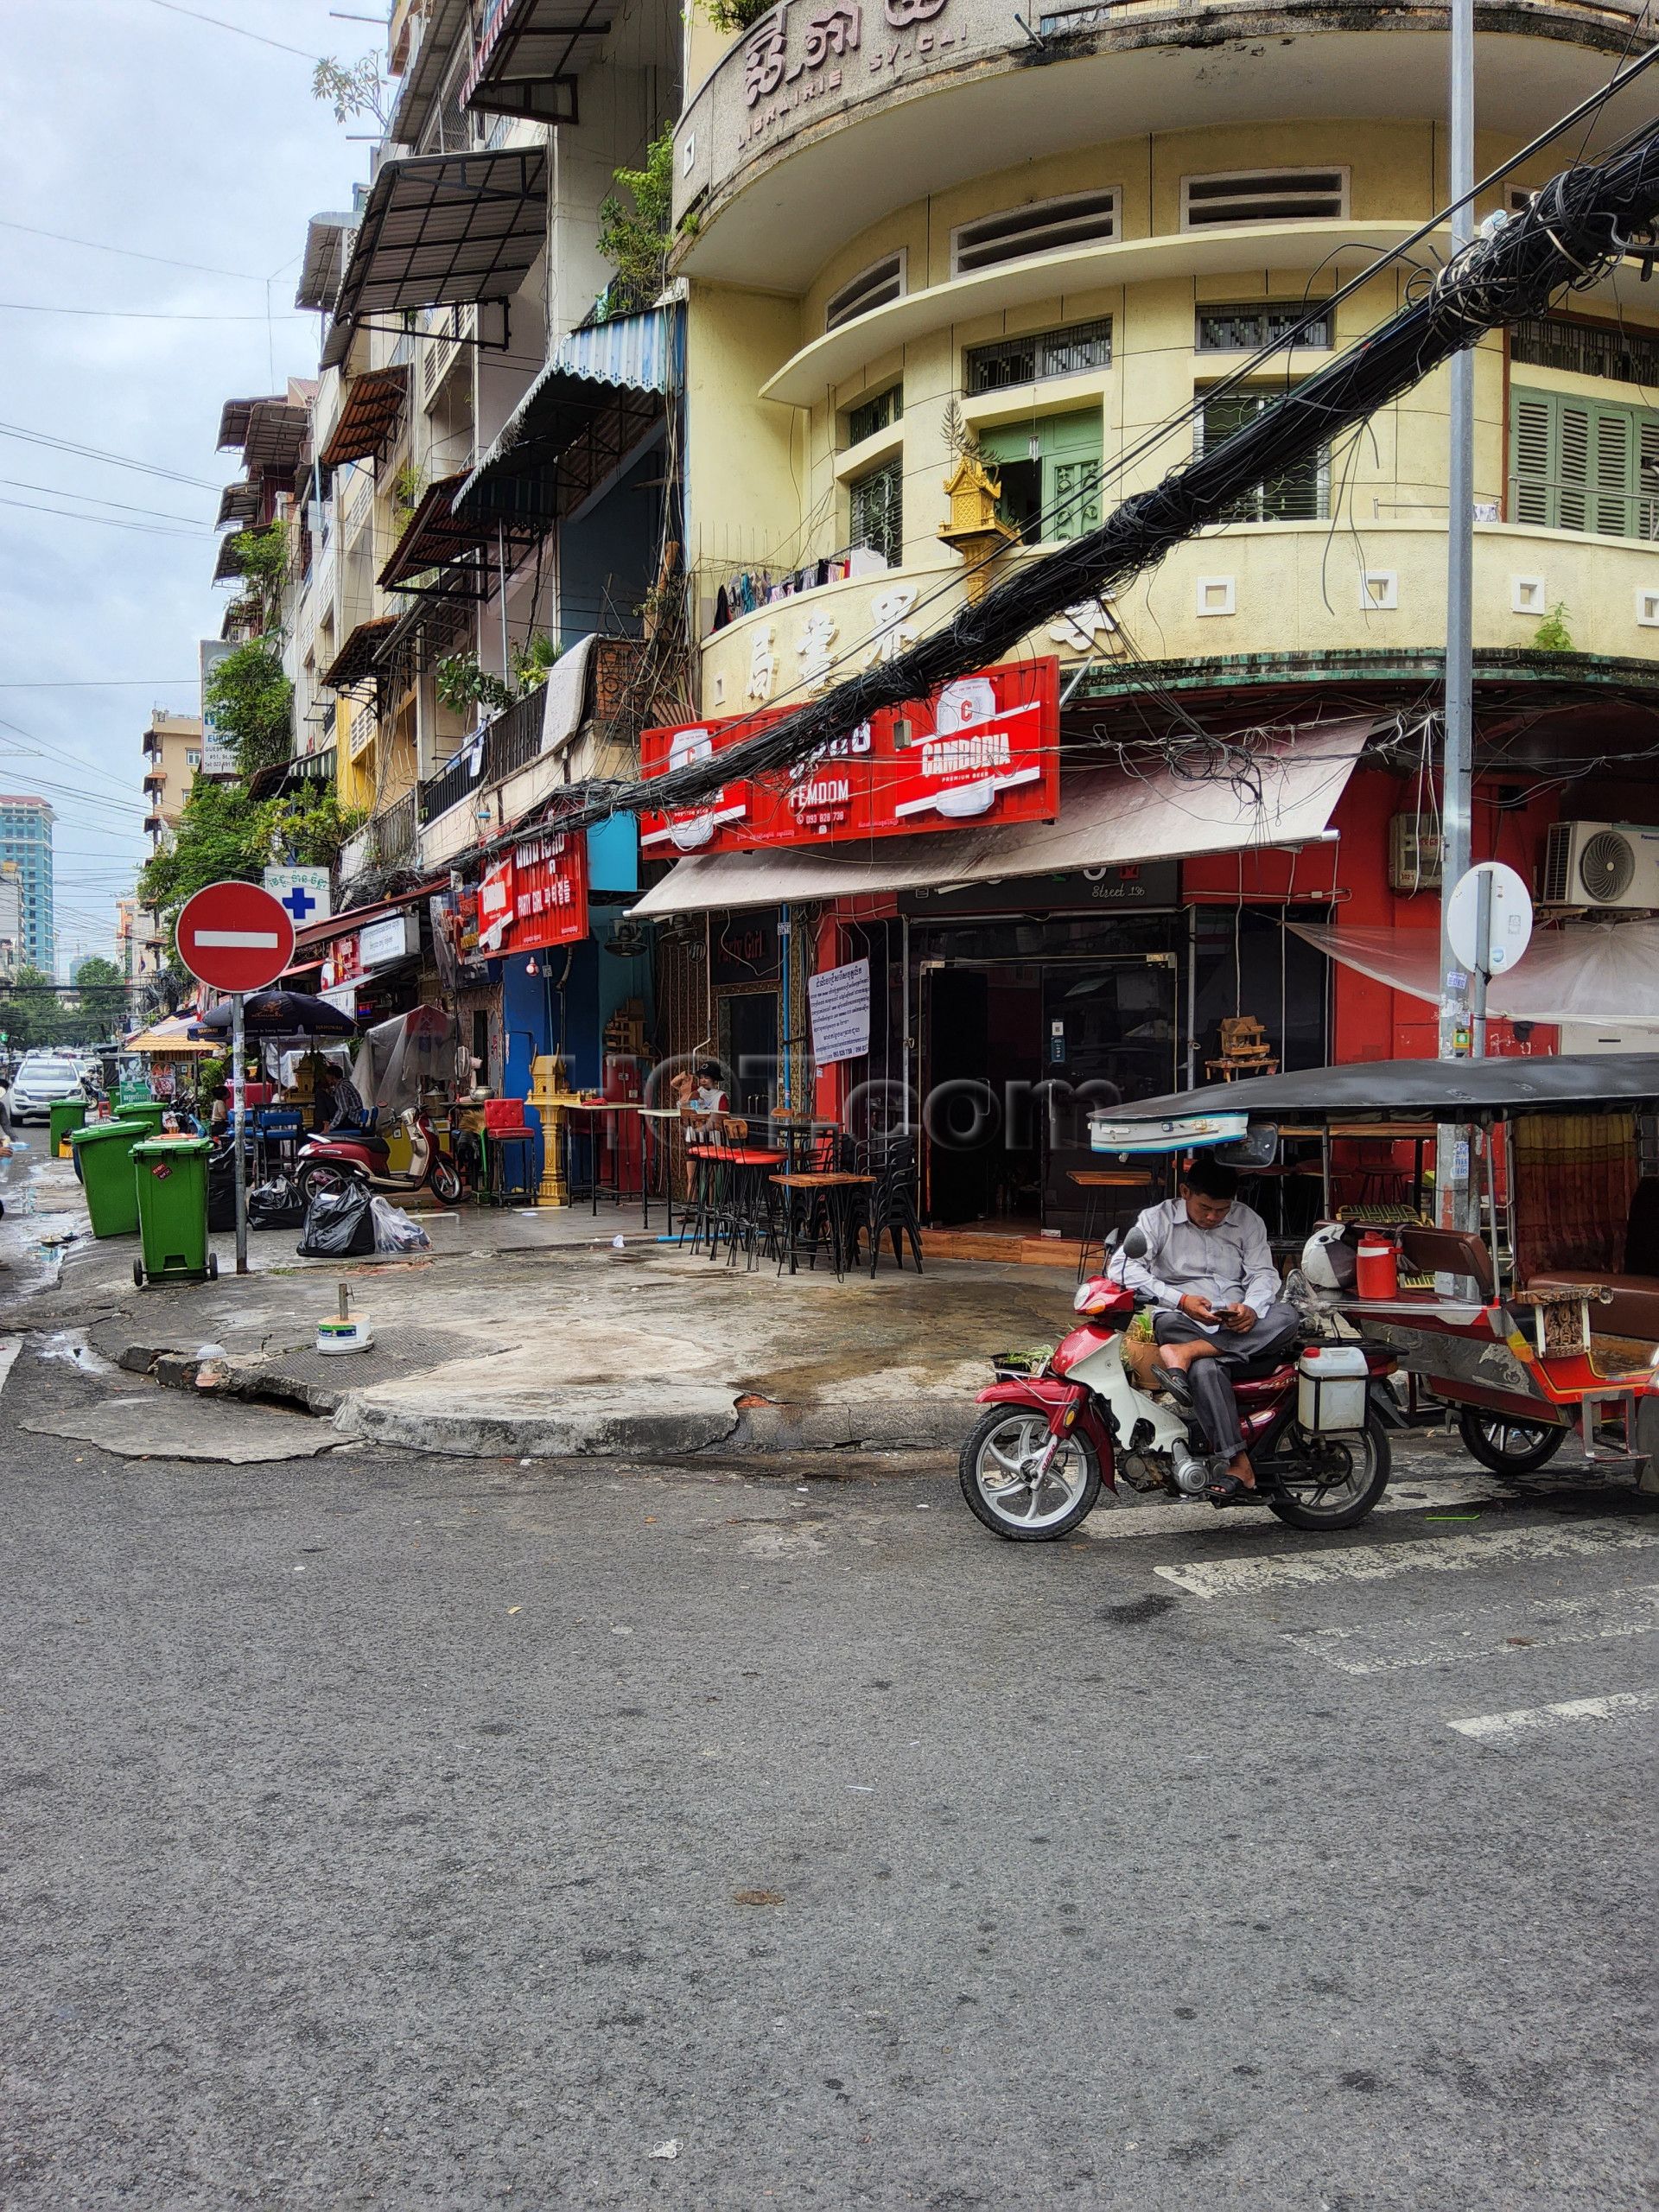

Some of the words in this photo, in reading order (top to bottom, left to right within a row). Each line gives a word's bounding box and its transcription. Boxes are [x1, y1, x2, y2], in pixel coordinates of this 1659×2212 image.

[737, 68, 843, 150] LIBRAIRIE
[922, 732, 1011, 778] CAMBODIA
[941, 774, 970, 783] PREMIUM
[972, 771, 989, 779] BEER
[789, 779, 849, 808] FEMDOM
[1091, 883, 1124, 899] Street
